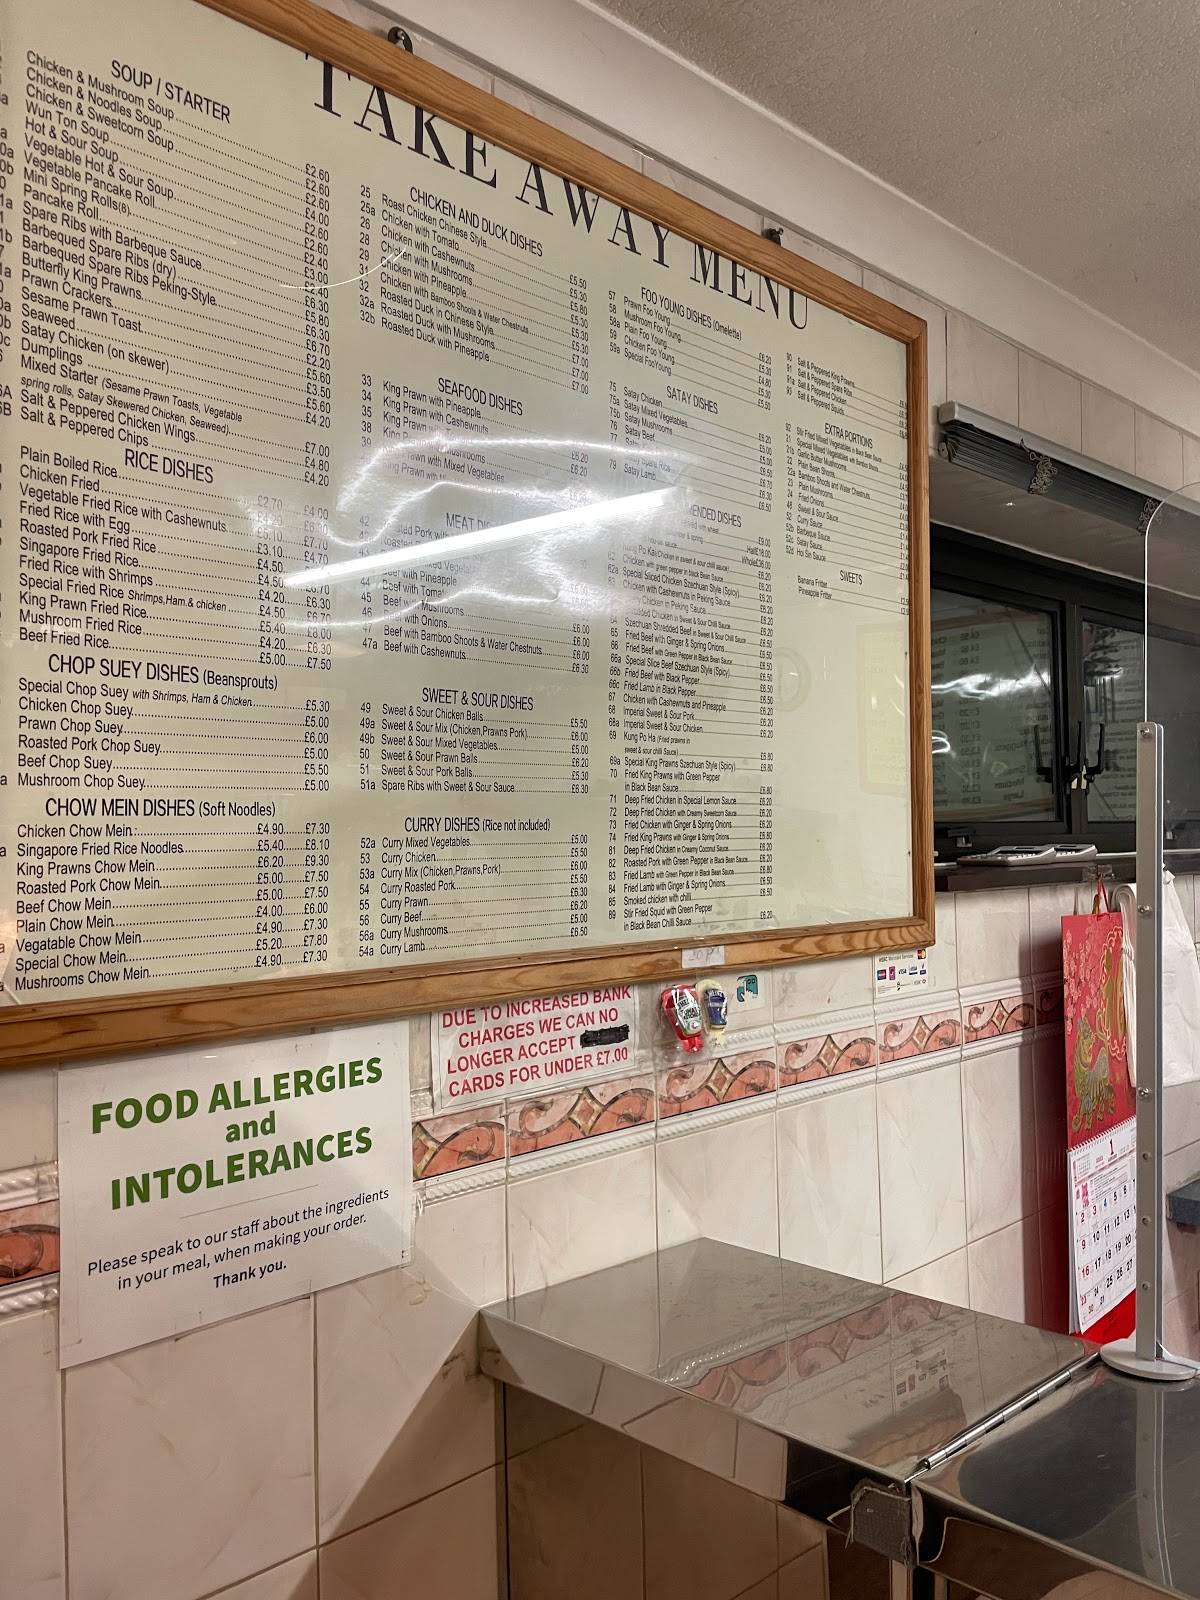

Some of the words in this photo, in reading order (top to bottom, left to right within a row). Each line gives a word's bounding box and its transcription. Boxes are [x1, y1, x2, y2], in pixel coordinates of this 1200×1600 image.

[111, 59, 152, 90] SOUP
[164, 82, 230, 124] STARTER
[26, 50, 73, 80] Chicken
[76, 70, 84, 84] &
[88, 74, 144, 108] Mushroom
[148, 98, 174, 122] Soup
[305, 164, 330, 183] £2.60
[305, 52, 497, 190] TAKE
[515, 163, 670, 268] AWAY
[690, 244, 808, 330] MENU
[410, 186, 456, 219] CHICKEN
[458, 208, 480, 229] AND
[482, 215, 508, 242] DUCK
[510, 231, 543, 258] DISHES
[22, 268, 58, 292] Prawn
[62, 282, 112, 308] Crackers
[641, 286, 658, 304] FOO
[659, 294, 686, 318] YOUNG
[686, 306, 712, 328] DISHES
[713, 319, 742, 341] (Omelette)
[438, 377, 486, 405] SEAFOOD
[489, 392, 522, 416] DISHES
[666, 386, 692, 406] SATAY
[694, 394, 718, 415] DISHES
[825, 422, 844, 438] EXTRA
[845, 430, 873, 450] PORTIONS
[124, 448, 158, 472] RICE
[163, 458, 214, 484] DISHES
[840, 570, 862, 585] SWEETS
[49, 654, 94, 677] CHOP
[100, 659, 142, 679] SUEY
[146, 663, 199, 684] DISHES
[203, 668, 278, 690] (Beansprouts)
[362, 638, 378, 650] 47a
[384, 640, 402, 652] Beef
[404, 642, 418, 655] with
[421, 644, 466, 660] Cashewnuts
[572, 664, 588, 674] £6.30
[422, 688, 458, 704] SWEET
[461, 690, 469, 705] &
[472, 692, 498, 708] SOUR
[500, 694, 534, 710] DISHES
[18, 773, 80, 786] Mushroom
[84, 774, 114, 790] Chop
[118, 776, 145, 792] Suey
[304, 780, 330, 792] £5.00
[360, 780, 376, 790] 51a
[382, 780, 405, 792] Spare
[408, 780, 424, 791] Ribs
[427, 781, 442, 792] with
[444, 782, 466, 792] Sweet
[469, 782, 474, 792] &
[476, 783, 492, 792] Sour
[494, 783, 515, 792] Sauce
[572, 784, 588, 794] £6.30
[610, 795, 617, 804] 71
[624, 795, 640, 806] Deep
[641, 796, 654, 804] Fried
[656, 796, 676, 804] Chicken
[678, 796, 682, 804] in
[684, 796, 702, 806] Special
[704, 796, 720, 804] Lemon
[722, 796, 736, 805] Sauce
[46, 798, 96, 816] CHOW
[102, 798, 138, 816] MEIN
[143, 800, 195, 816] DISHES
[199, 802, 226, 818] (Soft
[228, 802, 276, 818] Noodles)
[404, 818, 441, 832] CURRY
[444, 818, 480, 832] DISHES
[482, 818, 502, 832] (Rice
[504, 820, 516, 830] not
[518, 818, 550, 832] included)
[17, 824, 66, 838] Chicken
[69, 824, 100, 837] Chow
[104, 824, 132, 836] Mein
[257, 822, 284, 835] £4.90
[305, 822, 330, 834] £7.30
[360, 854, 370, 864] 53
[382, 852, 403, 868] Curry
[405, 851, 436, 862] Chicken
[571, 848, 588, 858] £5.50
[358, 946, 374, 957] 54a
[380, 944, 402, 958] Curry
[404, 942, 426, 952] Lamb
[570, 928, 588, 938] £6.50
[15, 973, 84, 991] Mushrooms
[88, 970, 120, 986] Chow
[124, 966, 150, 981] Mein
[256, 954, 282, 968] £4.90
[303, 951, 328, 964] £7.30
[442, 1006, 476, 1028] DUE
[480, 1003, 502, 1022] TO
[506, 992, 588, 1018] INCREASED
[592, 985, 631, 1002] BANK
[458, 1022, 534, 1048] CHARGES
[539, 1016, 563, 1034] WE
[566, 1012, 596, 1030] CAN
[599, 1008, 618, 1024] NO
[447, 1046, 513, 1074] LONGER
[518, 1036, 576, 1059] ACCEPT
[449, 1072, 504, 1097] CARDS
[510, 1066, 541, 1084] FOR
[544, 1055, 593, 1078] UNDER
[596, 1047, 628, 1066] £7.00
[92, 1089, 199, 1134] FOOD
[208, 1057, 382, 1114] ALLERGIES
[225, 1110, 276, 1142] and
[1109, 1140, 1114, 1156] 1
[112, 1126, 372, 1210] INTOLERANCES
[1080, 1212, 1085, 1223] 2
[1092, 1205, 1097, 1216] 3
[1114, 1191, 1118, 1201] 5
[87, 1253, 137, 1276] Please
[141, 1240, 184, 1264] speak
[187, 1237, 201, 1250] to
[204, 1230, 227, 1247] our
[231, 1220, 260, 1240] staff
[263, 1211, 300, 1233] about
[303, 1204, 322, 1222] the
[325, 1188, 389, 1216] ingredients
[1082, 1240, 1086, 1250] 9
[1092, 1230, 1100, 1242] 10
[1104, 1224, 1110, 1234] 11
[1114, 1216, 1120, 1228] 12
[1124, 1209, 1130, 1220] 13
[118, 1276, 132, 1290] in
[135, 1267, 168, 1288] your
[172, 1257, 210, 1276] meal,
[214, 1246, 250, 1264] when
[254, 1231, 301, 1252] making
[303, 1224, 330, 1242] your
[333, 1212, 366, 1230] order.
[1082, 1266, 1090, 1278] 16
[1094, 1257, 1101, 1270] 17
[1105, 1249, 1112, 1261] 18
[1116, 1242, 1122, 1253] 19
[1125, 1234, 1132, 1246] 20
[214, 1266, 256, 1288] Thank
[259, 1260, 287, 1278] you.
[1106, 1275, 1113, 1288] 25
[1116, 1266, 1123, 1280] 26
[1126, 1258, 1132, 1272] 27
